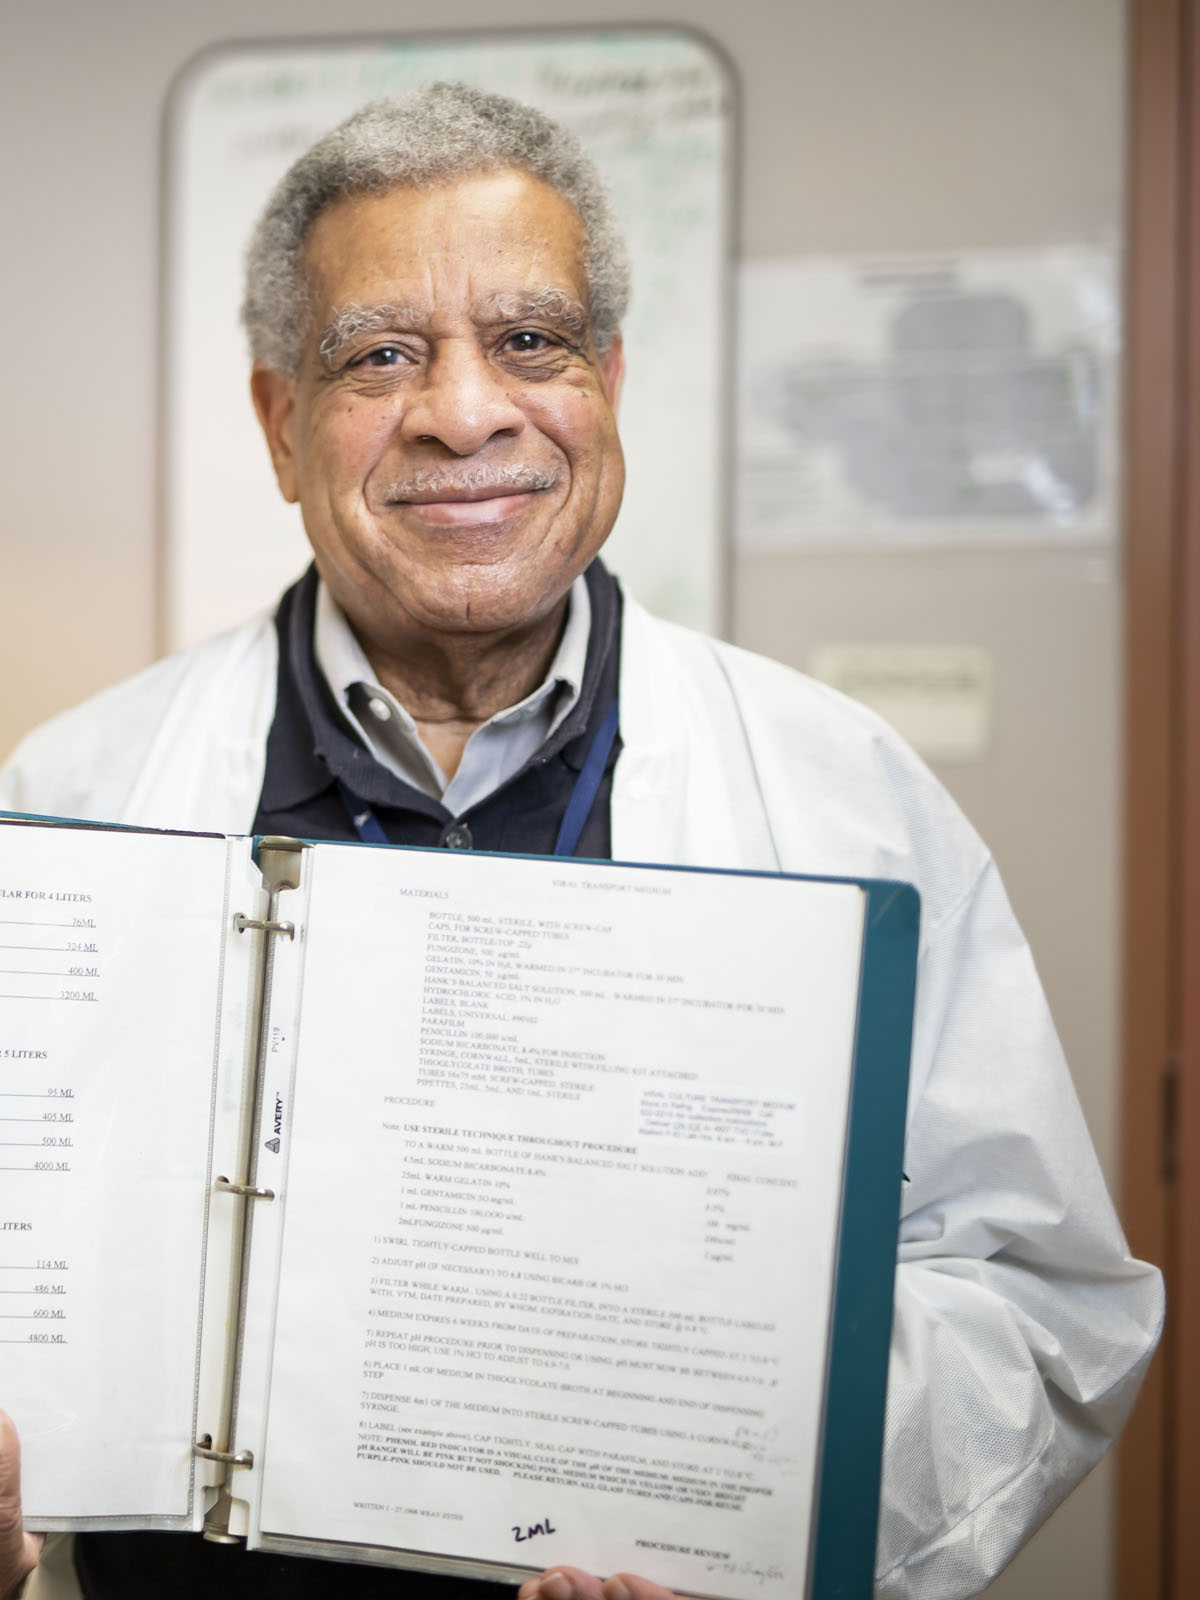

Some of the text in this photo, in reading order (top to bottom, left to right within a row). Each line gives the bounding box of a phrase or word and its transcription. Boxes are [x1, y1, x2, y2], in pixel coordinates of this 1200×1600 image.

[25, 889, 46, 901] FOR
[56, 891, 92, 904] LITERS
[400, 887, 449, 900] MATERIALS
[72, 917, 96, 929] 76ML
[66, 941, 81, 952] 324
[84, 942, 98, 954] ML
[68, 966, 83, 977] 400
[85, 967, 99, 978] ML
[60, 990, 80, 1002] 3200
[82, 991, 97, 1003] ML
[421, 1016, 465, 1028] PARAFILM
[272, 1027, 280, 1052] PV119
[421, 1027, 468, 1039] PENICILLIN
[420, 1037, 454, 1049] SODIUM
[11, 1048, 48, 1061] LITERS
[48, 1087, 57, 1098] 95
[60, 1088, 74, 1099] ML
[384, 1095, 435, 1108] PROCEDURE
[42, 1112, 56, 1123] 405
[59, 1113, 74, 1124] ML
[274, 1098, 283, 1134] AVERY
[404, 1123, 514, 1143] USE STERILE TECHNIQUE
[42, 1136, 56, 1147] 500
[59, 1137, 74, 1148] ML
[404, 1140, 416, 1150] TO
[427, 1142, 453, 1152] WARM
[33, 1160, 54, 1172] 4000
[56, 1162, 71, 1173] ML
[428, 1158, 462, 1170] SODIUM
[425, 1174, 492, 1187] WARM GELATIN
[421, 1188, 476, 1202] GENTAMICIN
[420, 1203, 467, 1216] PENICILLIN
[383, 1236, 408, 1248] SWIRL
[36, 1259, 51, 1271] 114
[54, 1260, 68, 1272] ML
[372, 1256, 426, 1270] 2) ADJUST pH
[33, 1284, 49, 1295] 486
[52, 1285, 66, 1296] ML
[412, 1280, 438, 1291] WHILE
[421, 1292, 443, 1303] DATE
[33, 1308, 48, 1319] 600
[51, 1309, 66, 1320] ML
[377, 1310, 413, 1322] MEDIUM
[416, 1313, 450, 1326] EXPIRES
[460, 1317, 489, 1329] WEEKS
[28, 1333, 48, 1344] 4800
[51, 1334, 66, 1345] ML
[376, 1329, 474, 1349] REPEAT PROCEDURE
[363, 1370, 384, 1380] STEP
[374, 1361, 473, 1379] PLACE OF MEDIUM
[371, 1391, 500, 1415] DISPENSE OF THE MEDIUM
[369, 1421, 396, 1432] LABEL
[400, 1447, 454, 1460] WILL PINK
[413, 1458, 464, 1471] SHOULD NOT
[354, 1501, 385, 1511] WRITTEN
